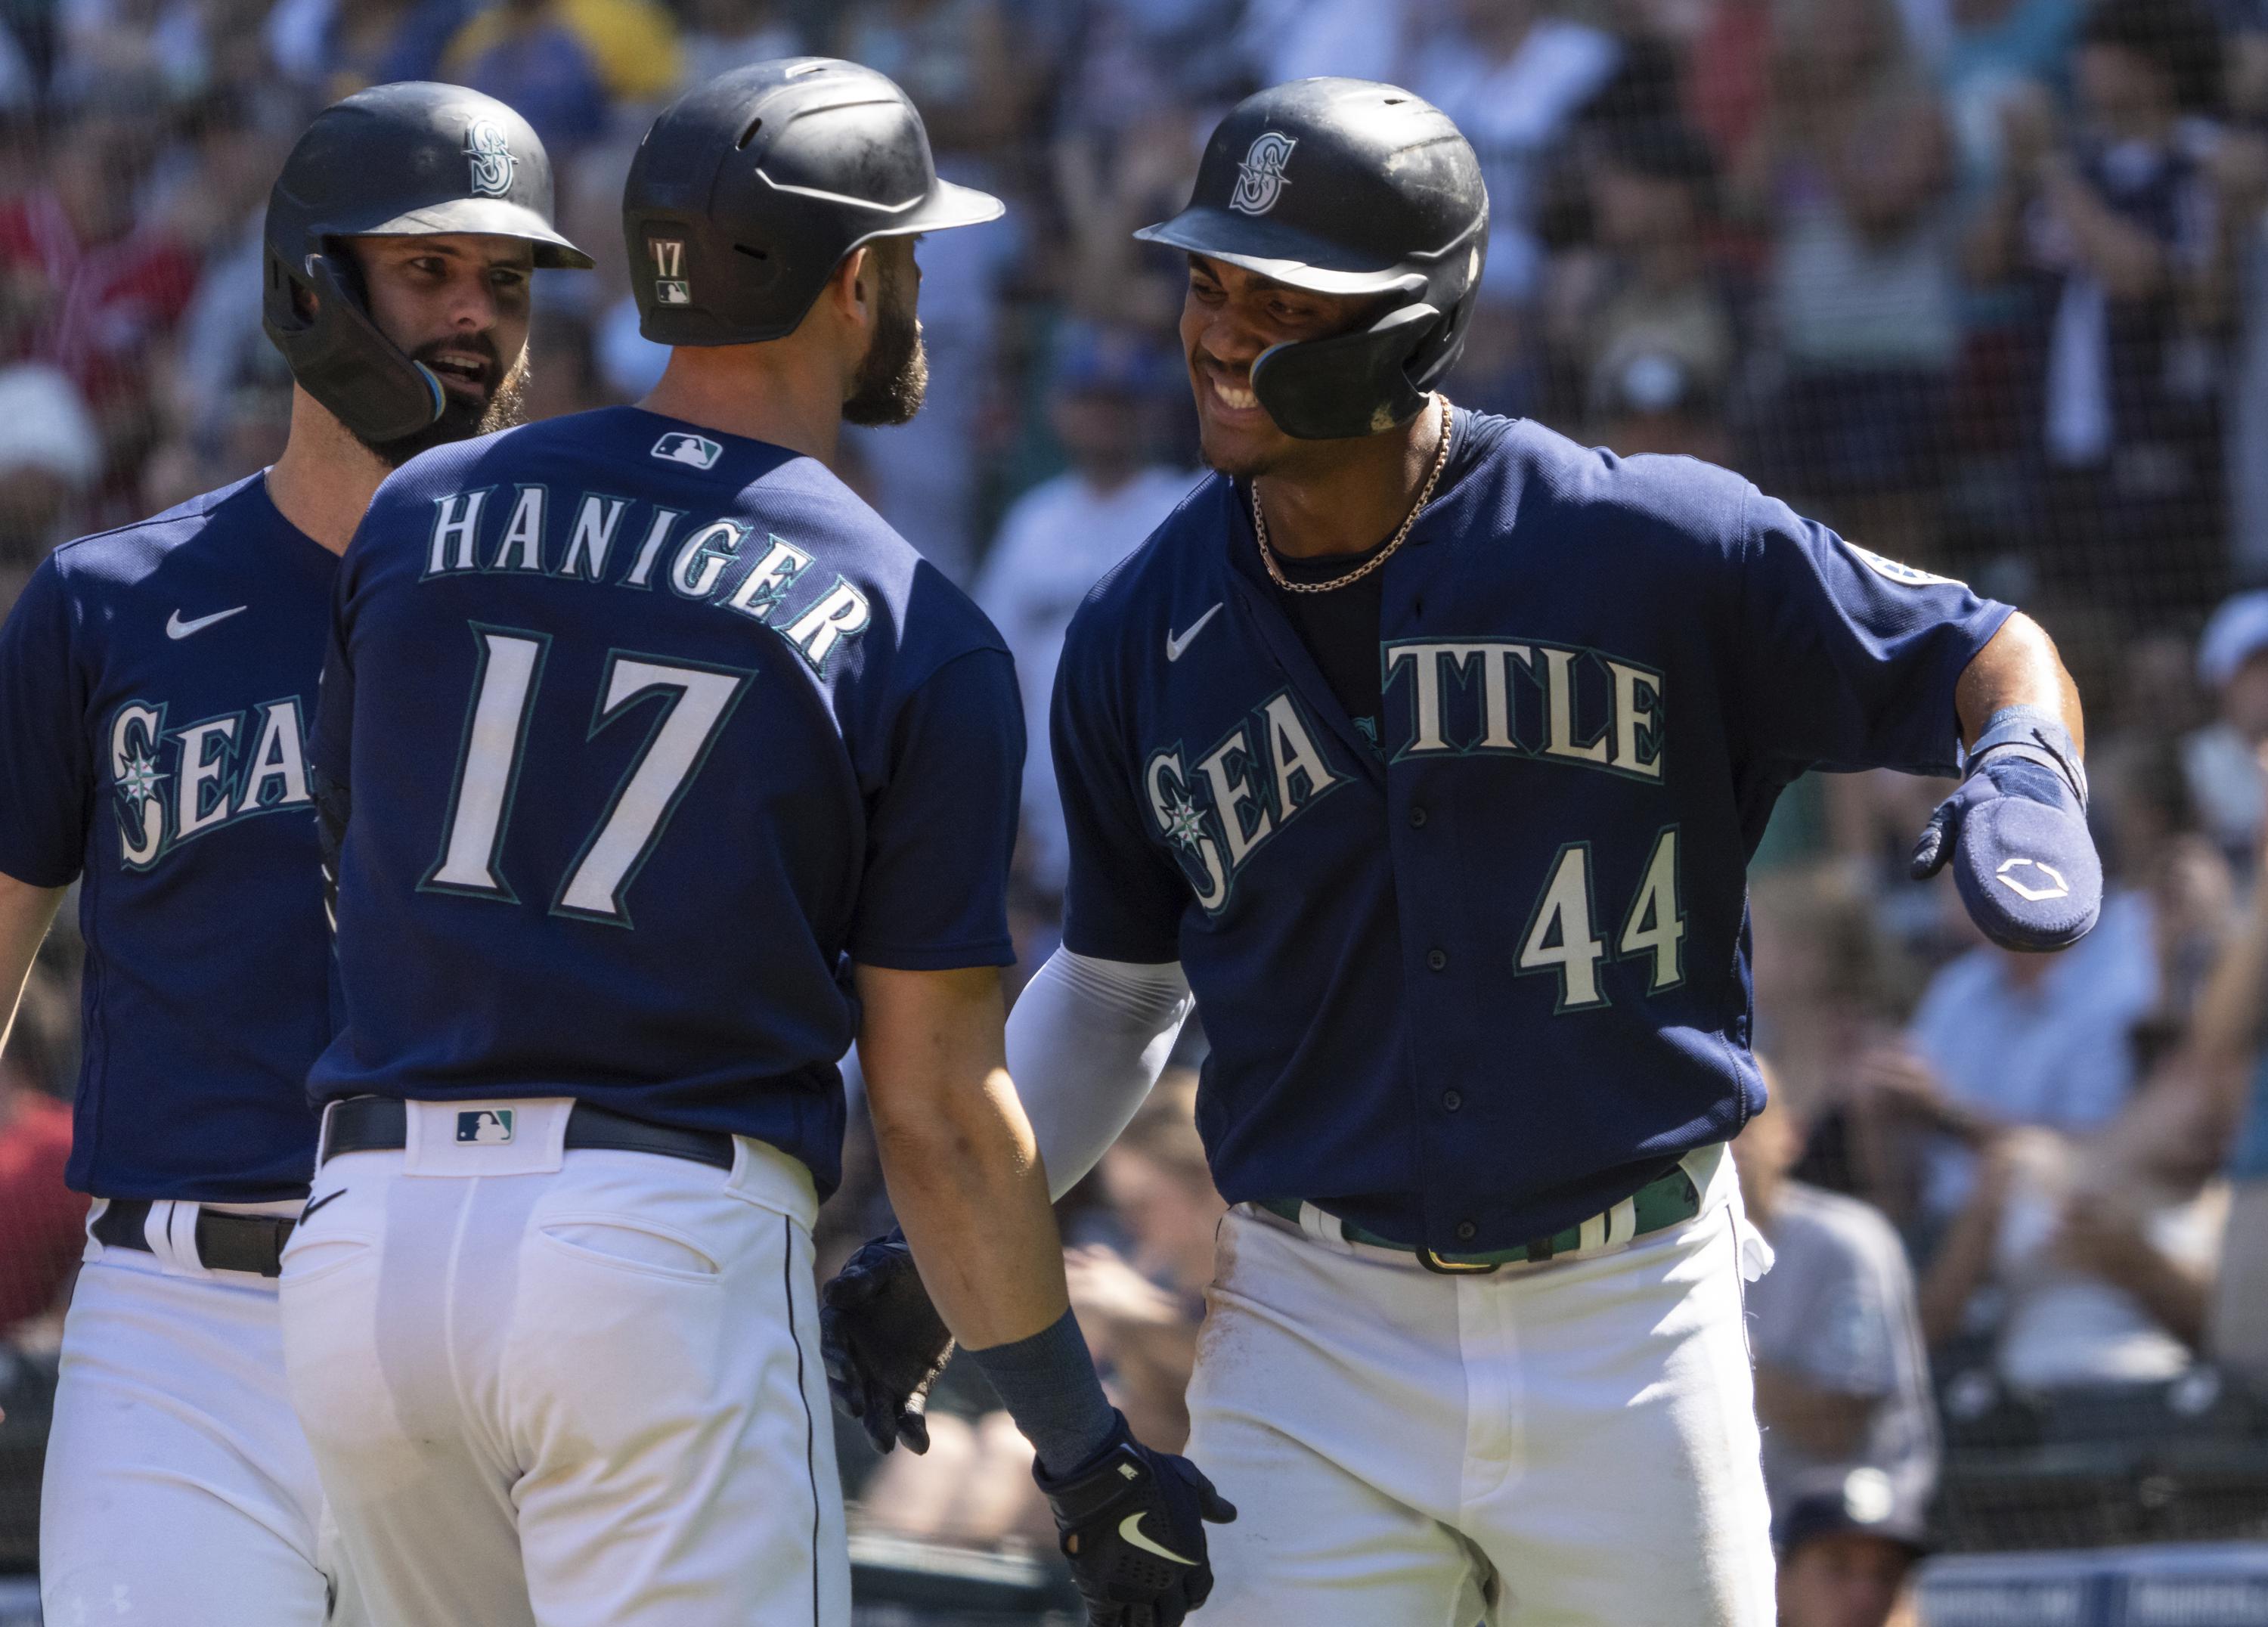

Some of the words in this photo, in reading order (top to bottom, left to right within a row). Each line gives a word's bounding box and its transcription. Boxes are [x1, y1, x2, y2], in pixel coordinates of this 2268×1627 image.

[655, 242, 681, 277] 17
[1230, 132, 1298, 214] S
[418, 484, 871, 680] HANIGER
[110, 695, 318, 871] SEA
[417, 621, 759, 930] 17
[1514, 824, 1688, 1015] 44
